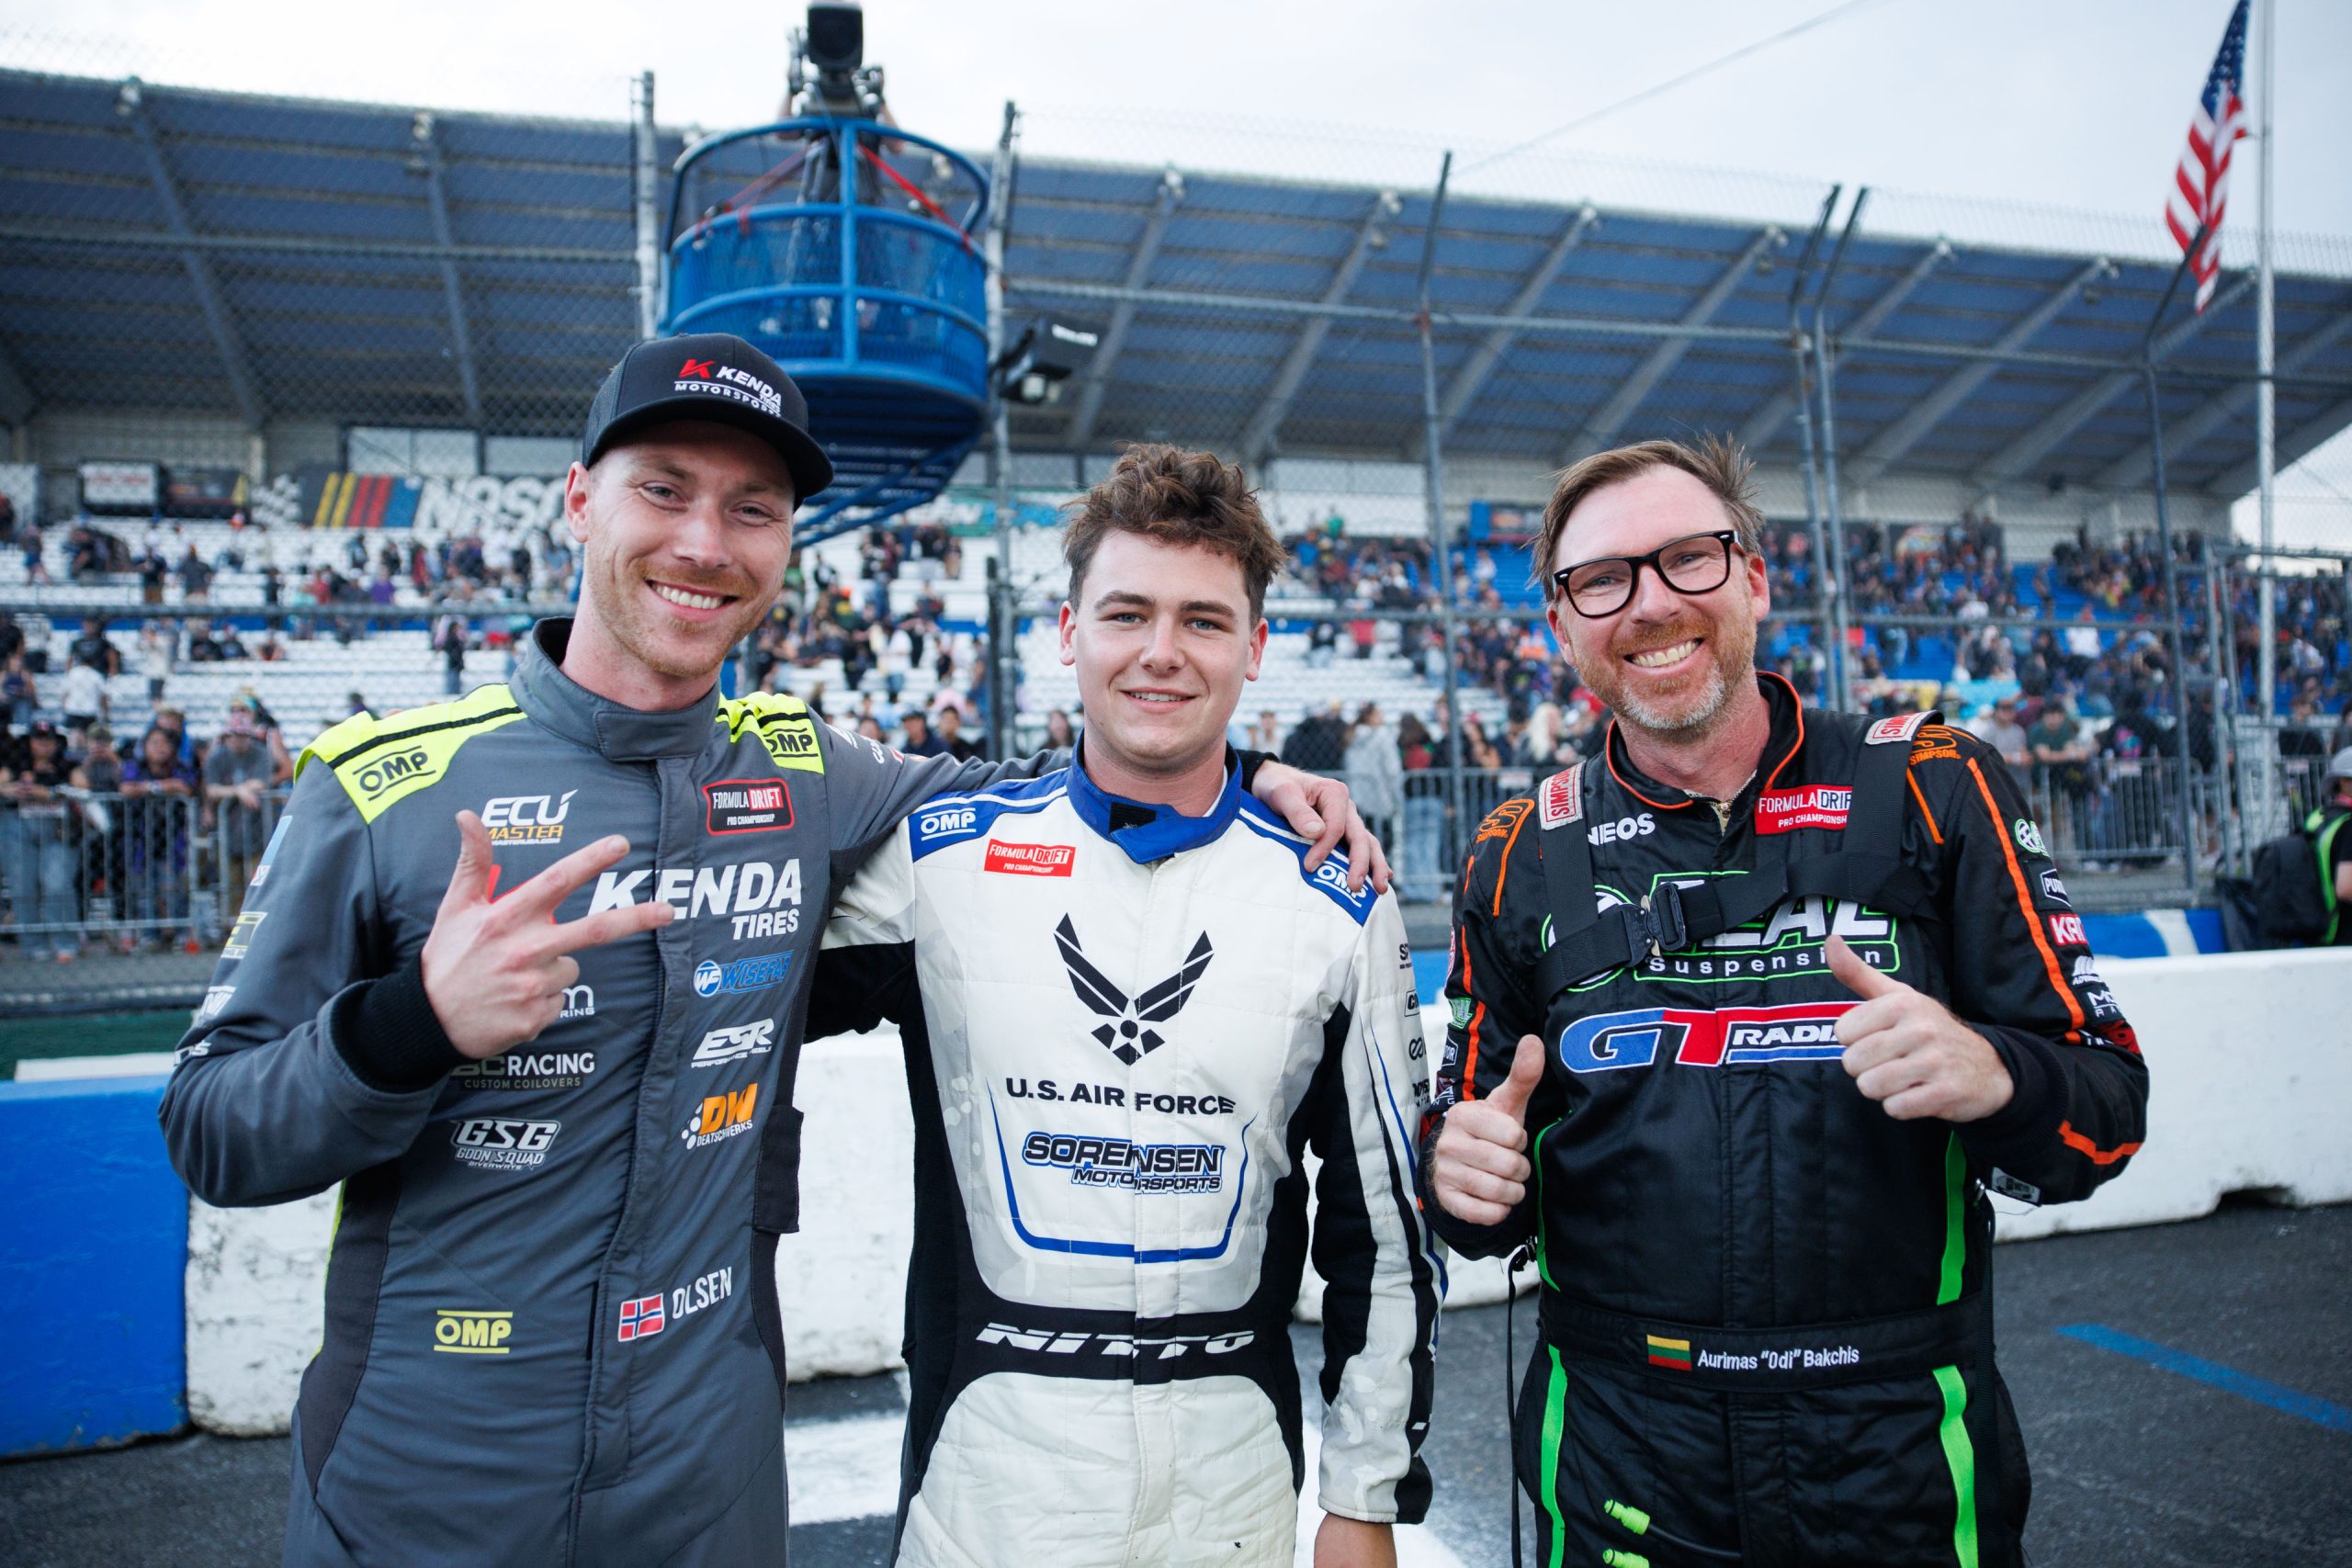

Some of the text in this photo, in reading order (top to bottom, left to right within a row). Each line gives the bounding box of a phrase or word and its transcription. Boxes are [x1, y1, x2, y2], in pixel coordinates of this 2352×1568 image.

[717, 366, 782, 406] KENDA
[359, 751, 428, 792] OMP
[481, 789, 579, 827] ECU
[712, 788, 781, 809] FORMULA DRIFT
[1758, 792, 1816, 814] FORMULA
[489, 825, 564, 840] MASTER
[921, 811, 976, 834] OMP
[1778, 817, 1793, 828] PRO
[989, 844, 1069, 863] FORMULA DRIFT
[1003, 863, 1014, 871] PRO
[588, 859, 802, 919] KENDA
[731, 908, 799, 941] TIRES
[1648, 947, 1881, 976] Suspensin
[693, 1018, 775, 1061] ESR
[507, 1052, 595, 1077] RACING
[464, 1077, 581, 1089] CUSTOM COILOVERS
[1006, 1077, 1237, 1115] U.S. AIR FORCE
[699, 1082, 758, 1135] DW
[457, 1119, 558, 1151] GSG
[457, 1147, 545, 1168] GOON SQUAD
[1023, 1134, 1222, 1175] SORENSEN
[1073, 1168, 1221, 1191] MOTORSPORTS
[672, 1266, 732, 1319] OLSEN
[435, 1317, 512, 1347] OMP
[976, 1322, 1255, 1360] NITTO
[1698, 1349, 1758, 1370] Aurimas
[1804, 1345, 1860, 1368] Bakchis
